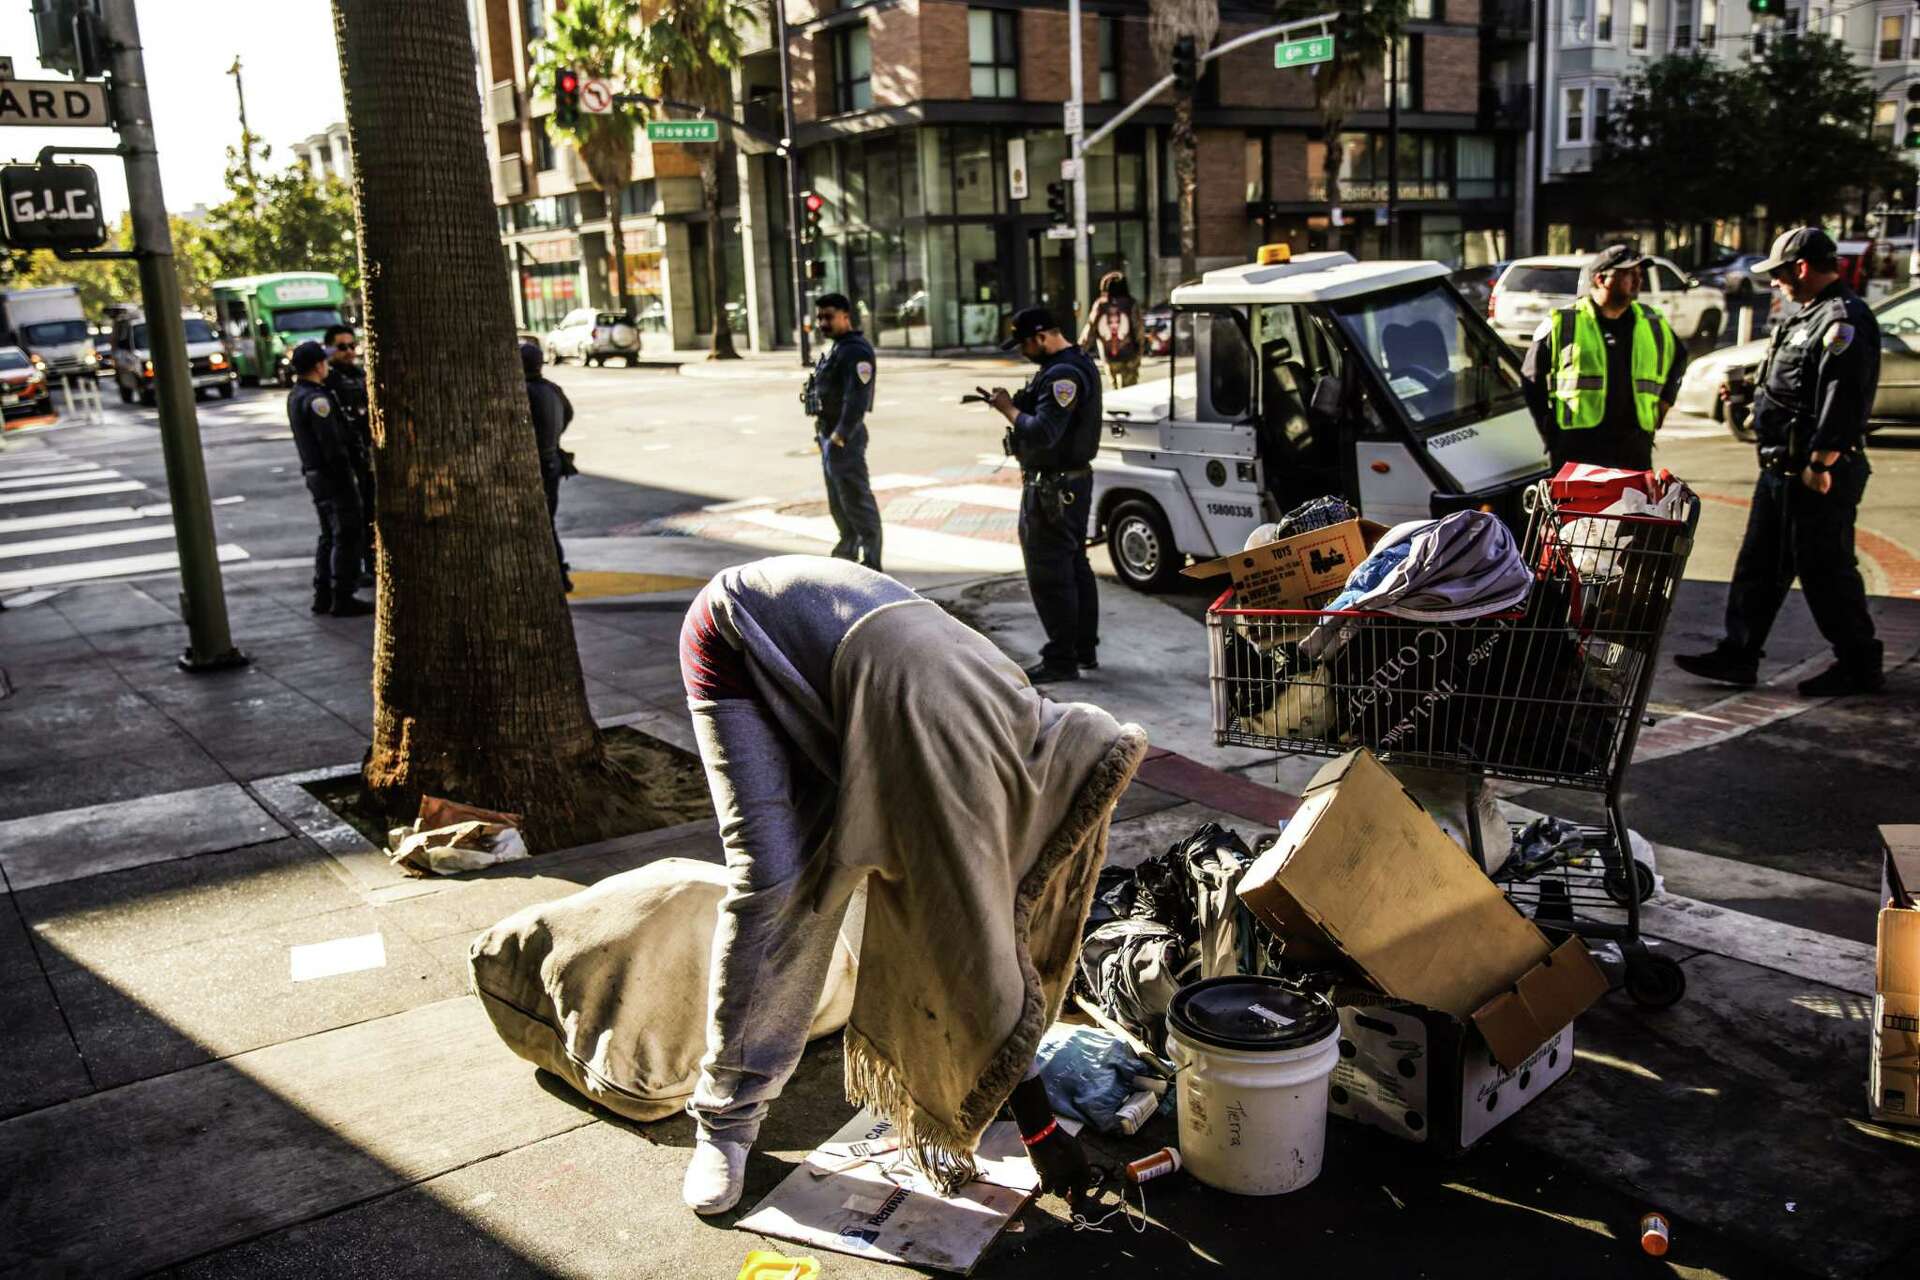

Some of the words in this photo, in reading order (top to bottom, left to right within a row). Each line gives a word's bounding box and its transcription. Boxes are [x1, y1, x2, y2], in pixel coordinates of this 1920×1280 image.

[1309, 43, 1322, 57] St
[0, 88, 91, 118] ARD
[655, 127, 709, 137] Howard
[1207, 503, 1253, 518] 15800336
[1272, 545, 1292, 560] TOYS
[1225, 1099, 1248, 1147] Tierra
[868, 1188, 911, 1227] Renown
